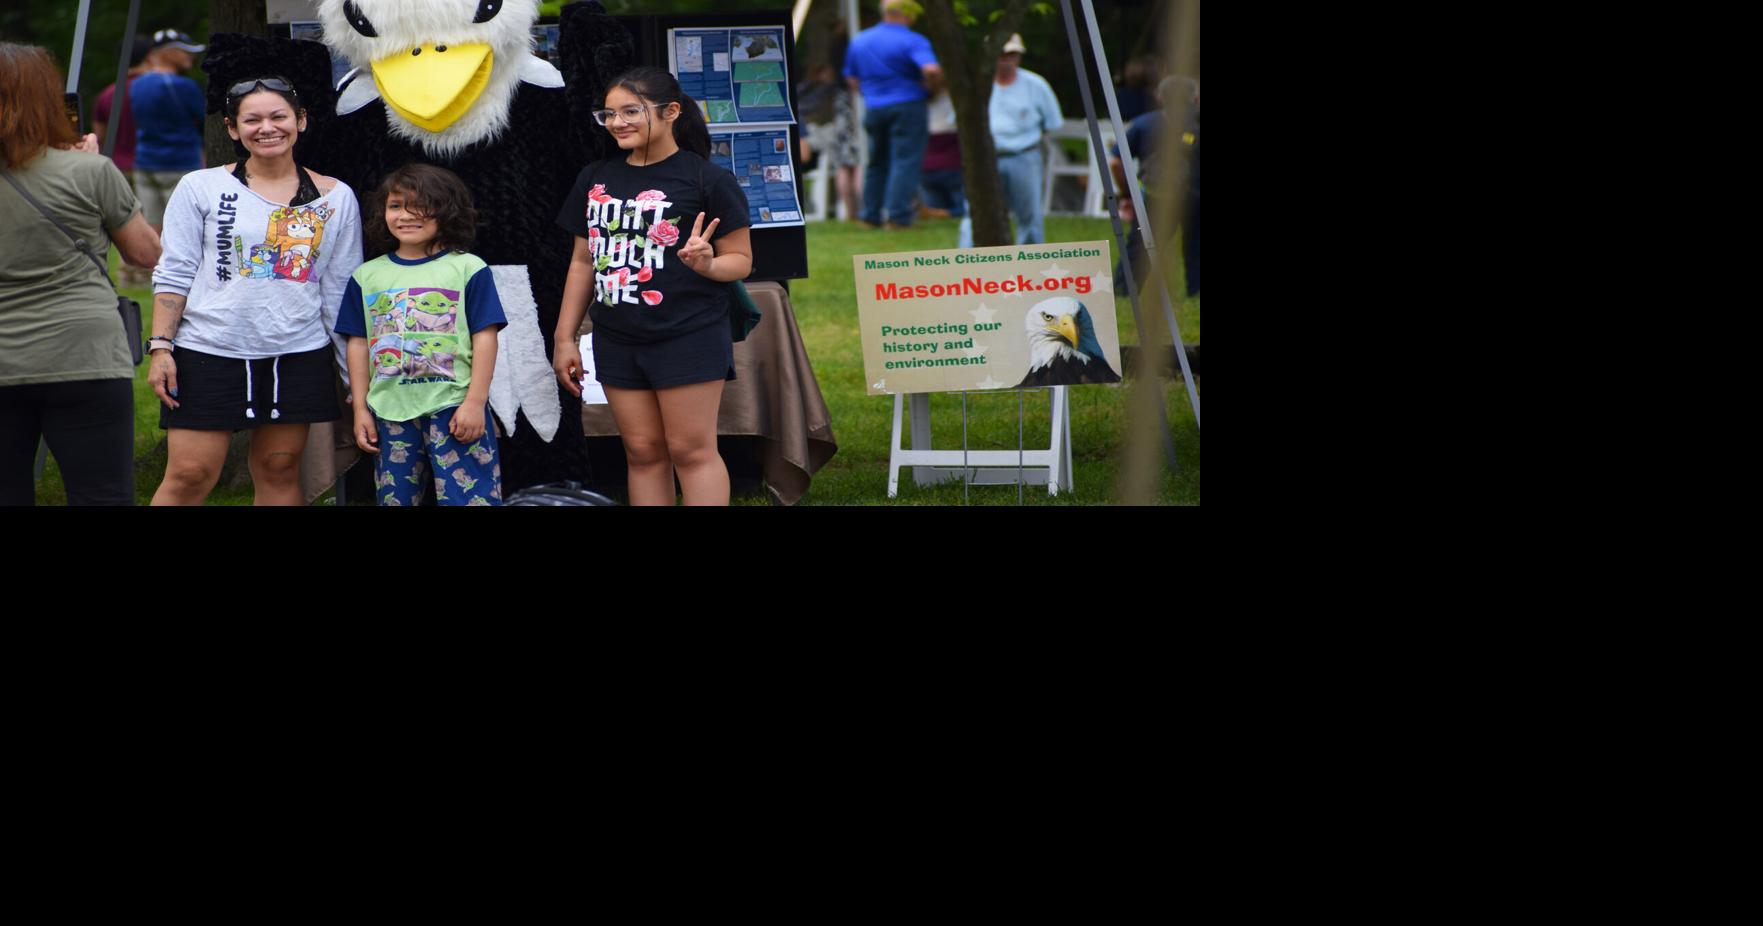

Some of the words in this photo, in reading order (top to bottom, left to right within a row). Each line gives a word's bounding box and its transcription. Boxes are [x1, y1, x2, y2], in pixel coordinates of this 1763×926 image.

[216, 192, 239, 282] #MUMLIFE
[864, 258, 910, 270] Mason
[914, 255, 950, 267] Neck
[955, 251, 1013, 265] Citizens
[1016, 247, 1101, 261] Association
[595, 272, 640, 305] ME
[875, 274, 1092, 301] MasonNeck.org
[881, 322, 968, 337] Protecting
[973, 320, 1002, 332] our
[883, 340, 938, 354] history
[943, 337, 974, 350] and
[885, 354, 987, 370] environment
